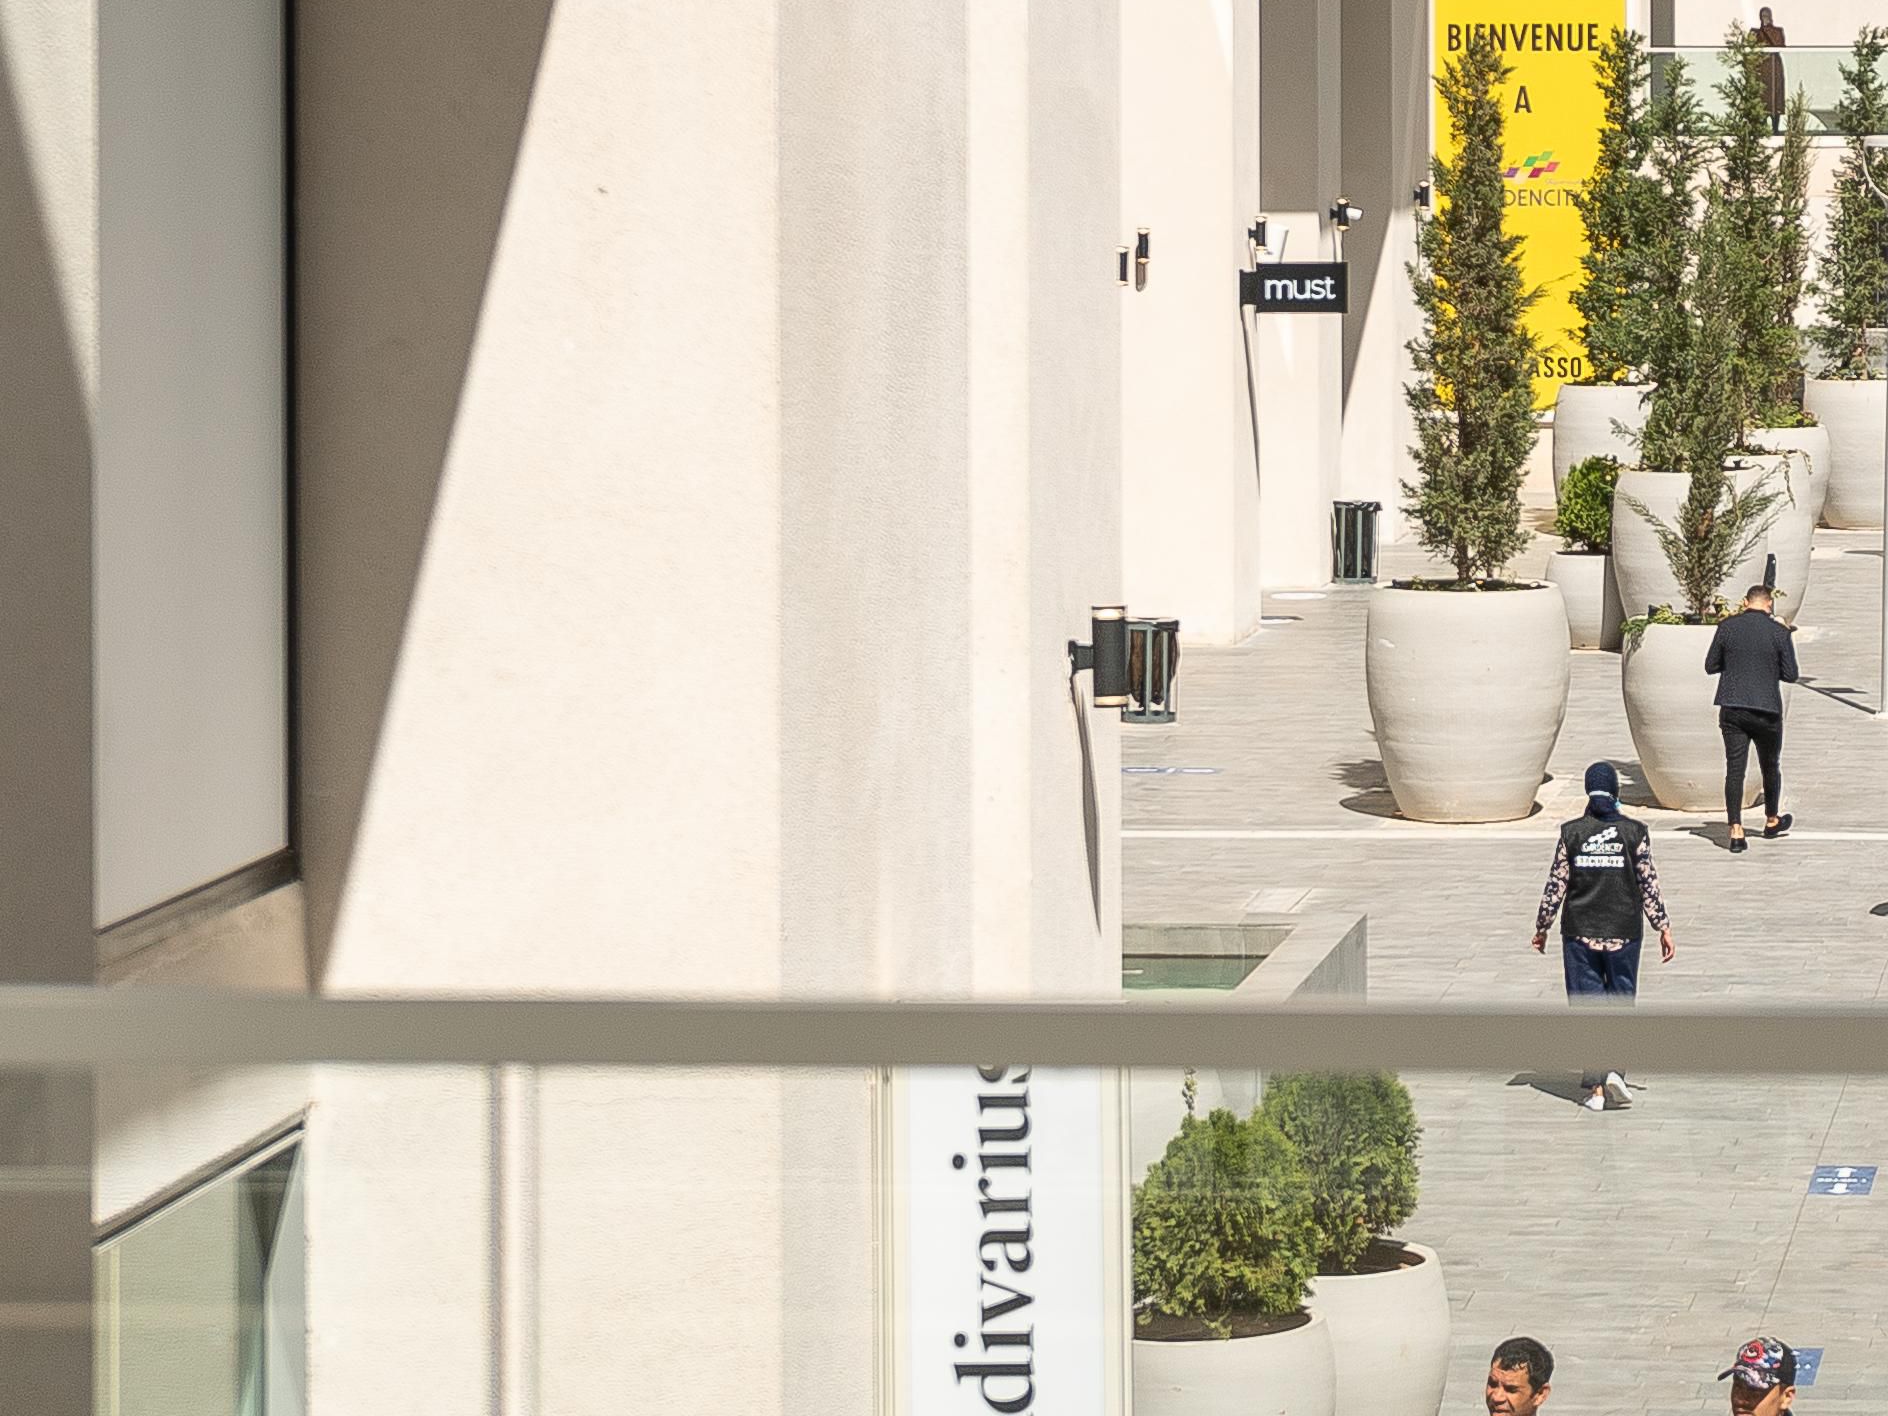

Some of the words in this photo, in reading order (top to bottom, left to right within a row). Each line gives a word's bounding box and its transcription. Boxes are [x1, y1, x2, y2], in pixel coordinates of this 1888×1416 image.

[1447, 23, 1600, 52] BIENVENUE
[1514, 85, 1533, 114] A
[1264, 276, 1337, 300] must
